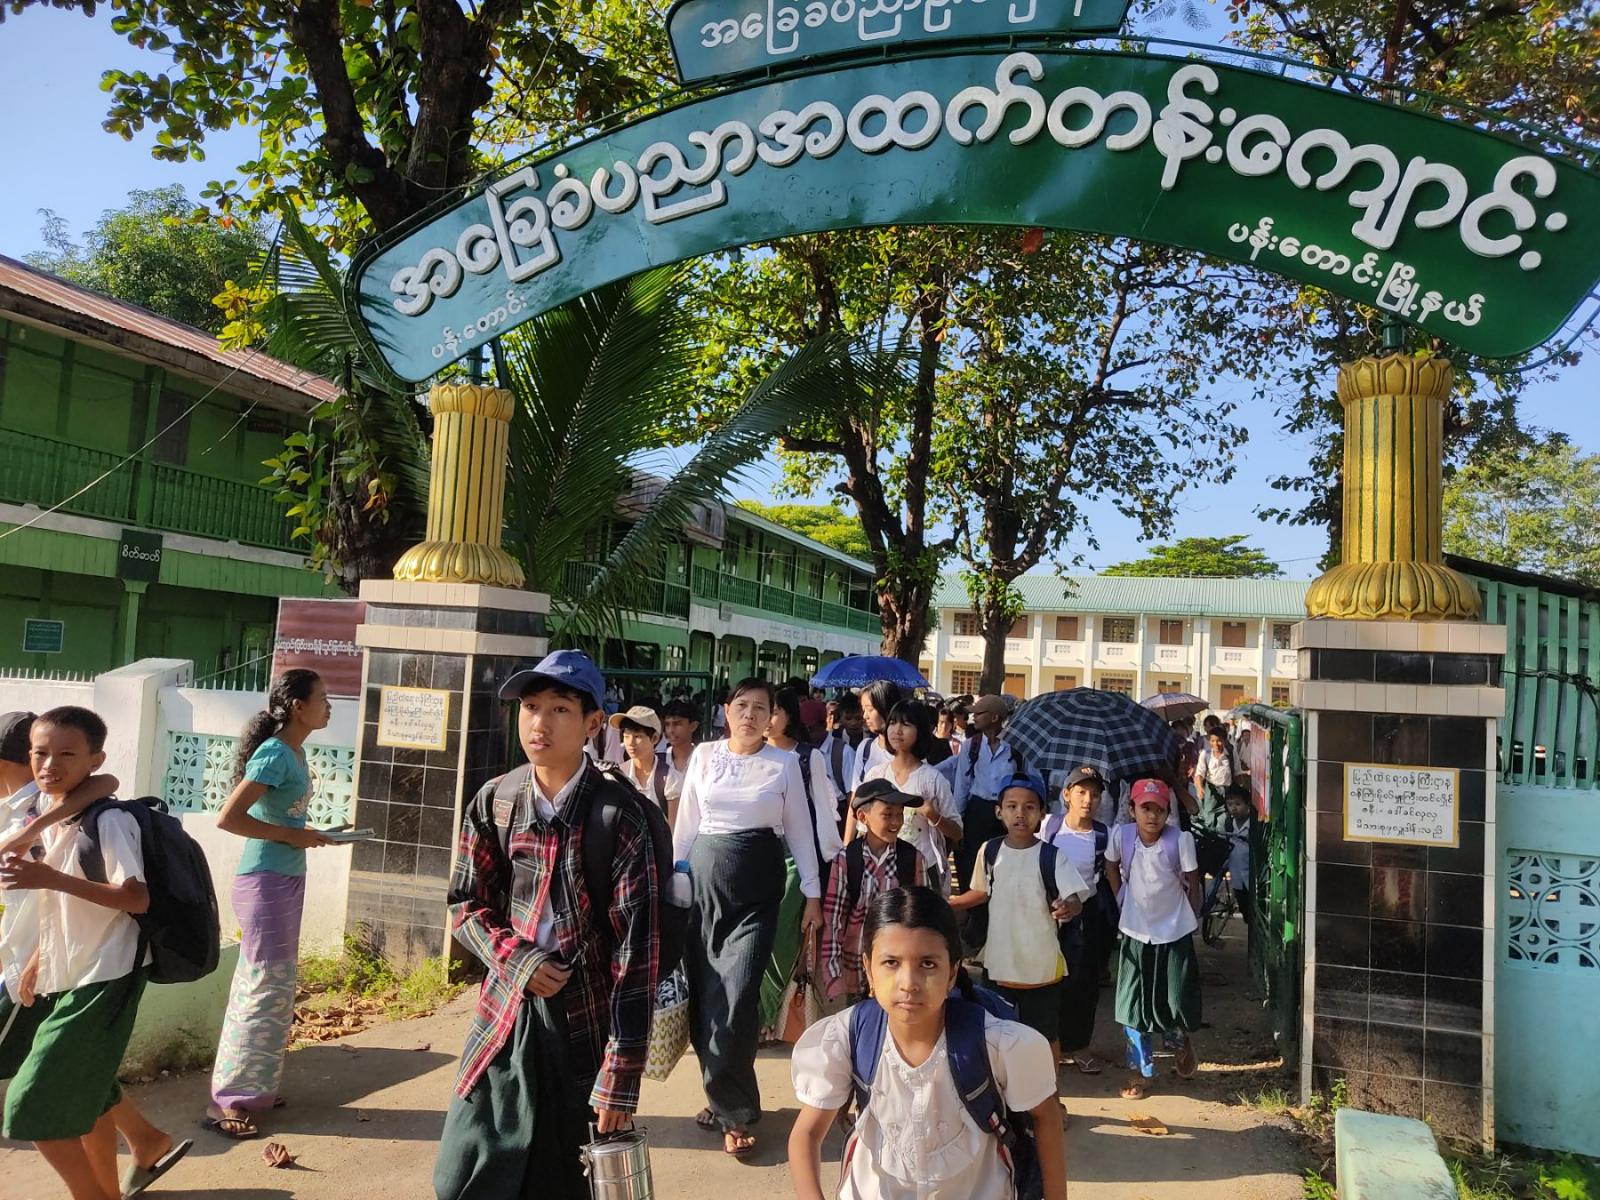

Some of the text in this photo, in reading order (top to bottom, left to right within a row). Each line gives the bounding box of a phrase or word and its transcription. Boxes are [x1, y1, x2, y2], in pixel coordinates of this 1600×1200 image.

[389, 52, 1568, 317] အခြေခံပညာအထက်တန်းကျောင်း
[431, 289, 528, 358] ပန်းတောင်း
[121, 544, 161, 562] စိတ်ဓာတ်
